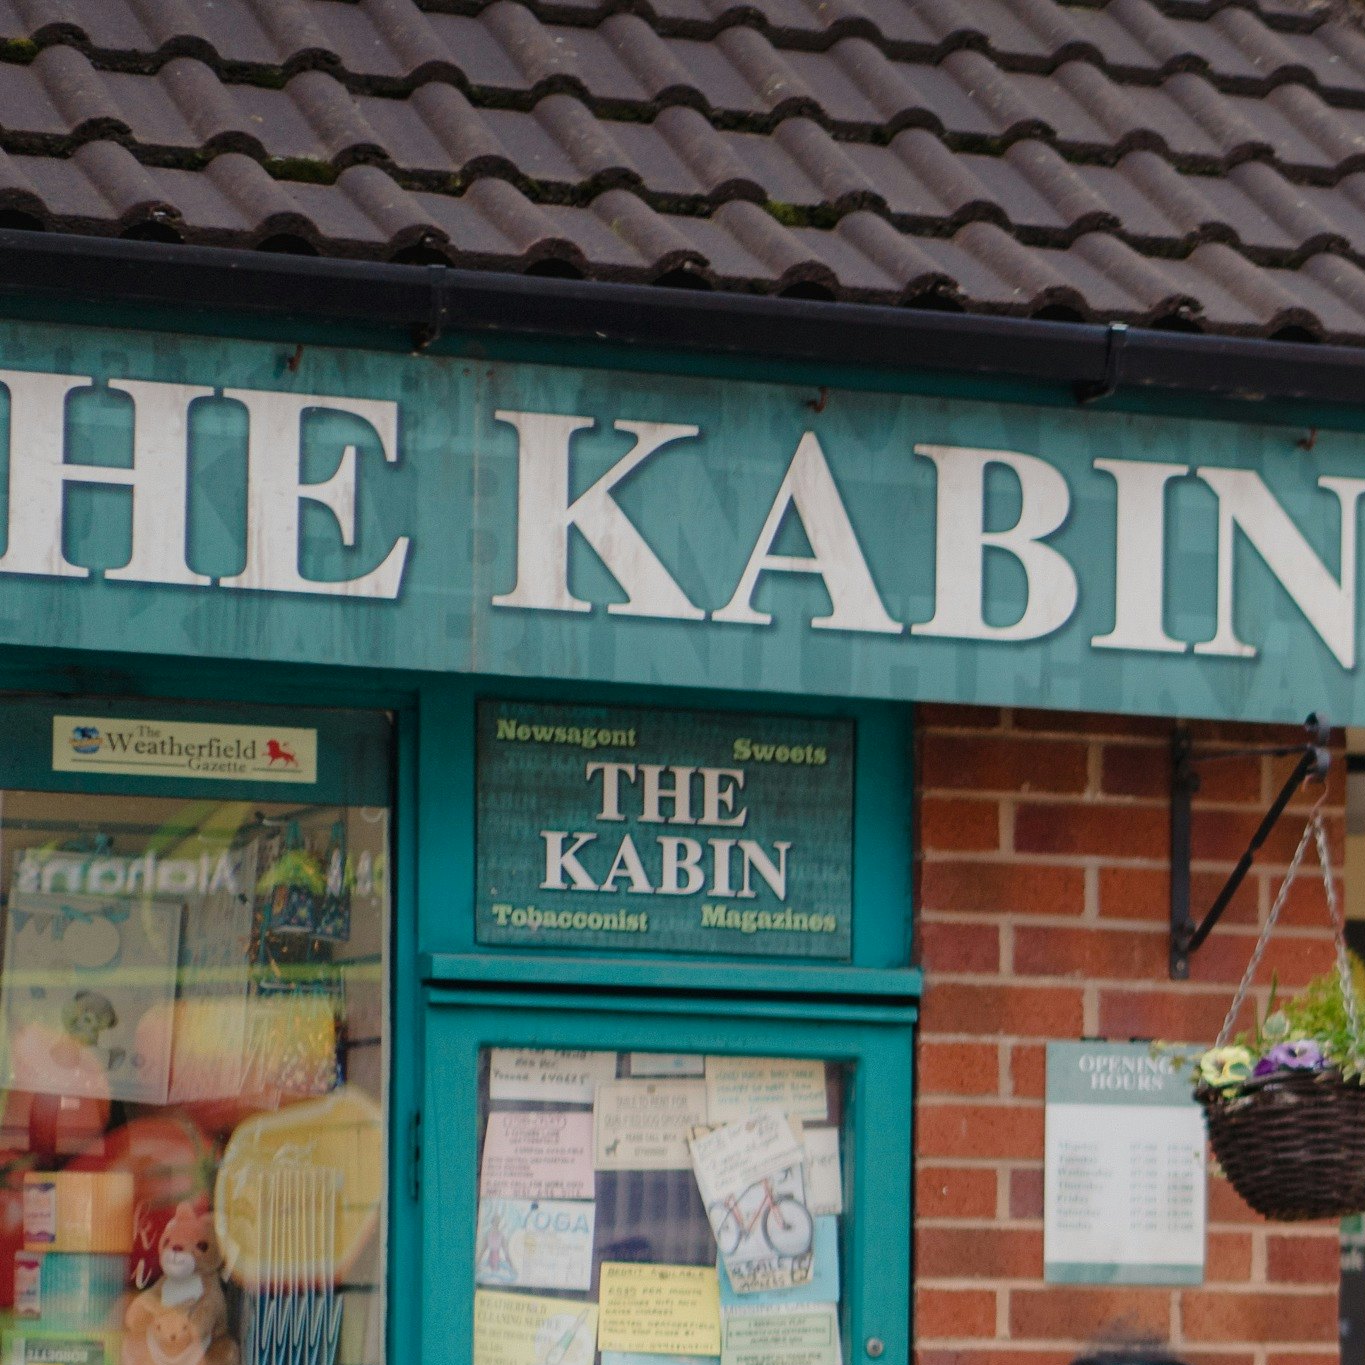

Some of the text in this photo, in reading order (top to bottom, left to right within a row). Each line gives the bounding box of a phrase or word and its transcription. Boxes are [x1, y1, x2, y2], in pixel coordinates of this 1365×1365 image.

[137, 725, 161, 738] The
[496, 718, 637, 750] Newsagent
[106, 732, 257, 760] Weatherfield
[733, 737, 828, 765] Sweets
[187, 758, 247, 774] Gazette
[585, 760, 748, 828] THE
[539, 829, 792, 901] KABIN
[492, 903, 649, 933] Tobacconist
[701, 904, 836, 933] Magazines
[1079, 1054, 1173, 1076] OPENING
[1090, 1073, 1165, 1091] HOURS
[514, 1206, 590, 1233] YOGA
